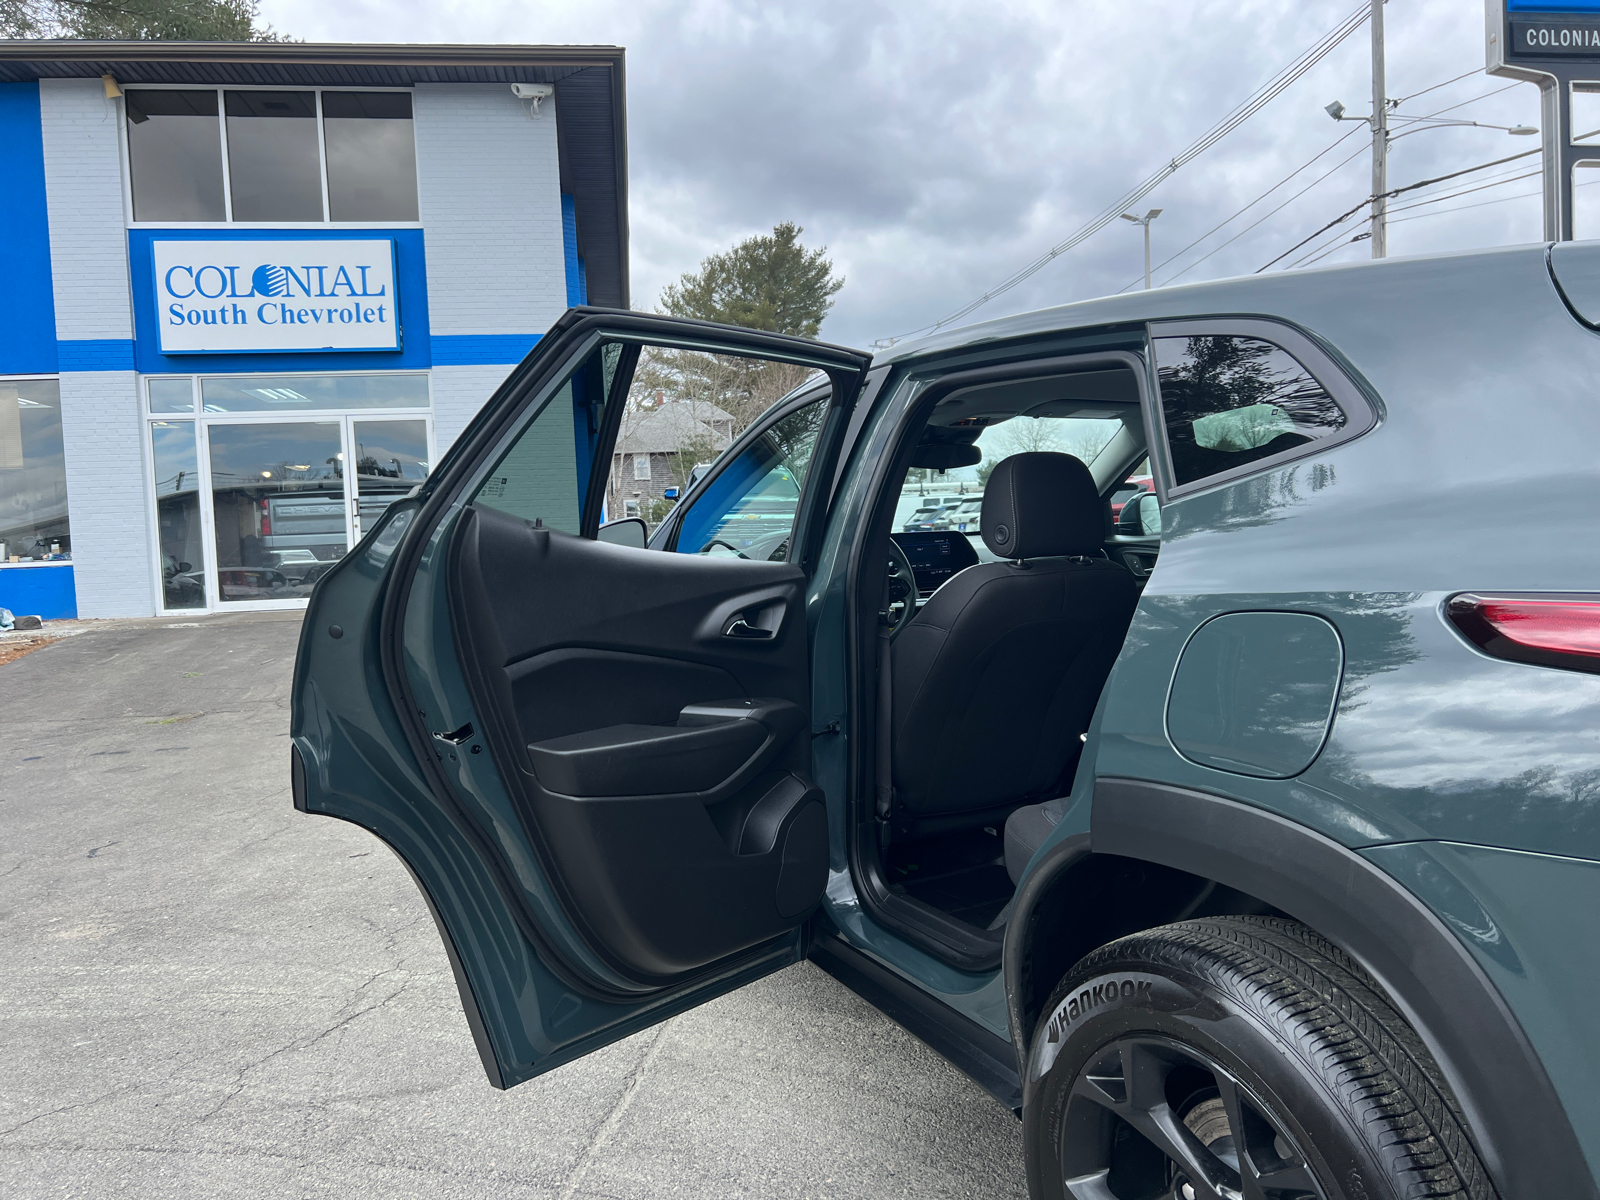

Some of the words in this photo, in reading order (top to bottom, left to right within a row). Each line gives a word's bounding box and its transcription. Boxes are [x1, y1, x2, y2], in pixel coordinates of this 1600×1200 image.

[1526, 28, 1600, 47] COLONIA
[164, 263, 386, 299] COLONIAL
[168, 303, 248, 326] South
[256, 302, 388, 325] Chevrolet
